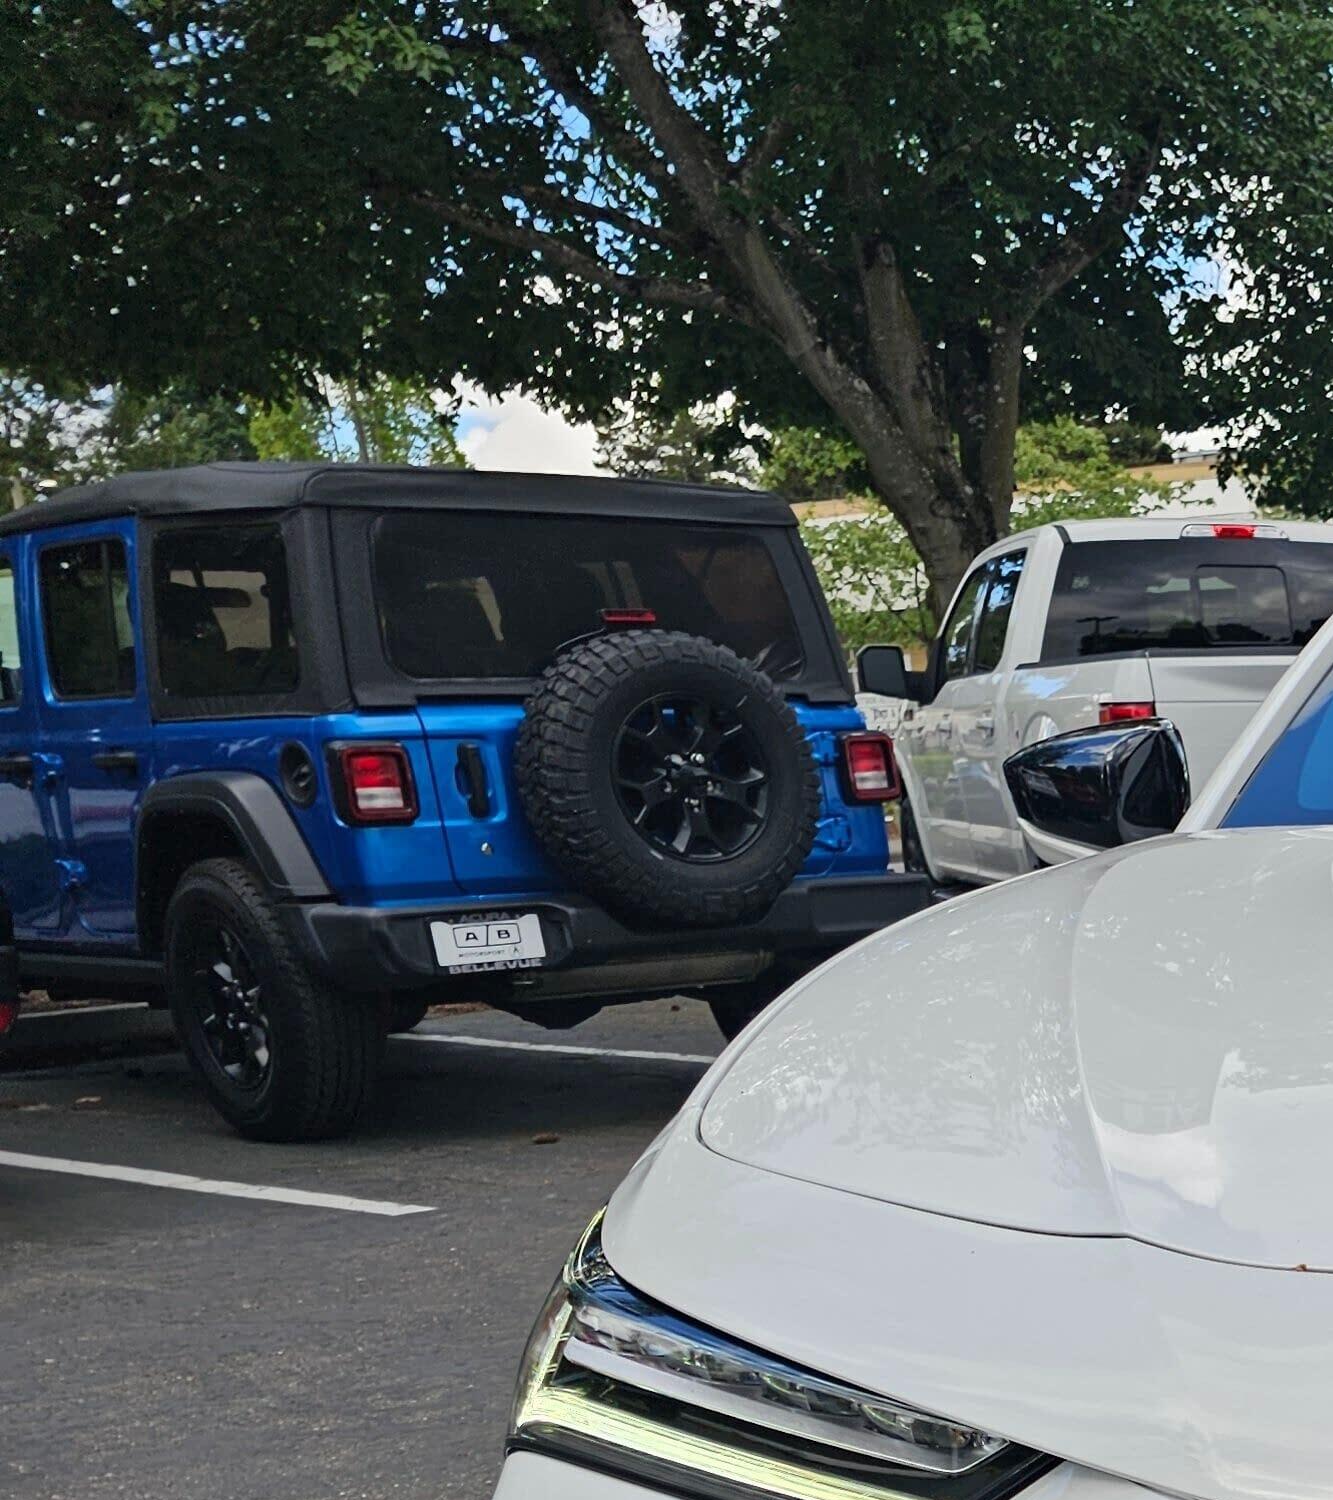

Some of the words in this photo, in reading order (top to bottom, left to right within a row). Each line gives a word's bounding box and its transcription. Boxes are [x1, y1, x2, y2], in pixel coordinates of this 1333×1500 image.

[459, 912, 511, 923] ACURA
[465, 932, 478, 941] A
[496, 930, 511, 939] B
[449, 958, 542, 974] BELLEVUE
